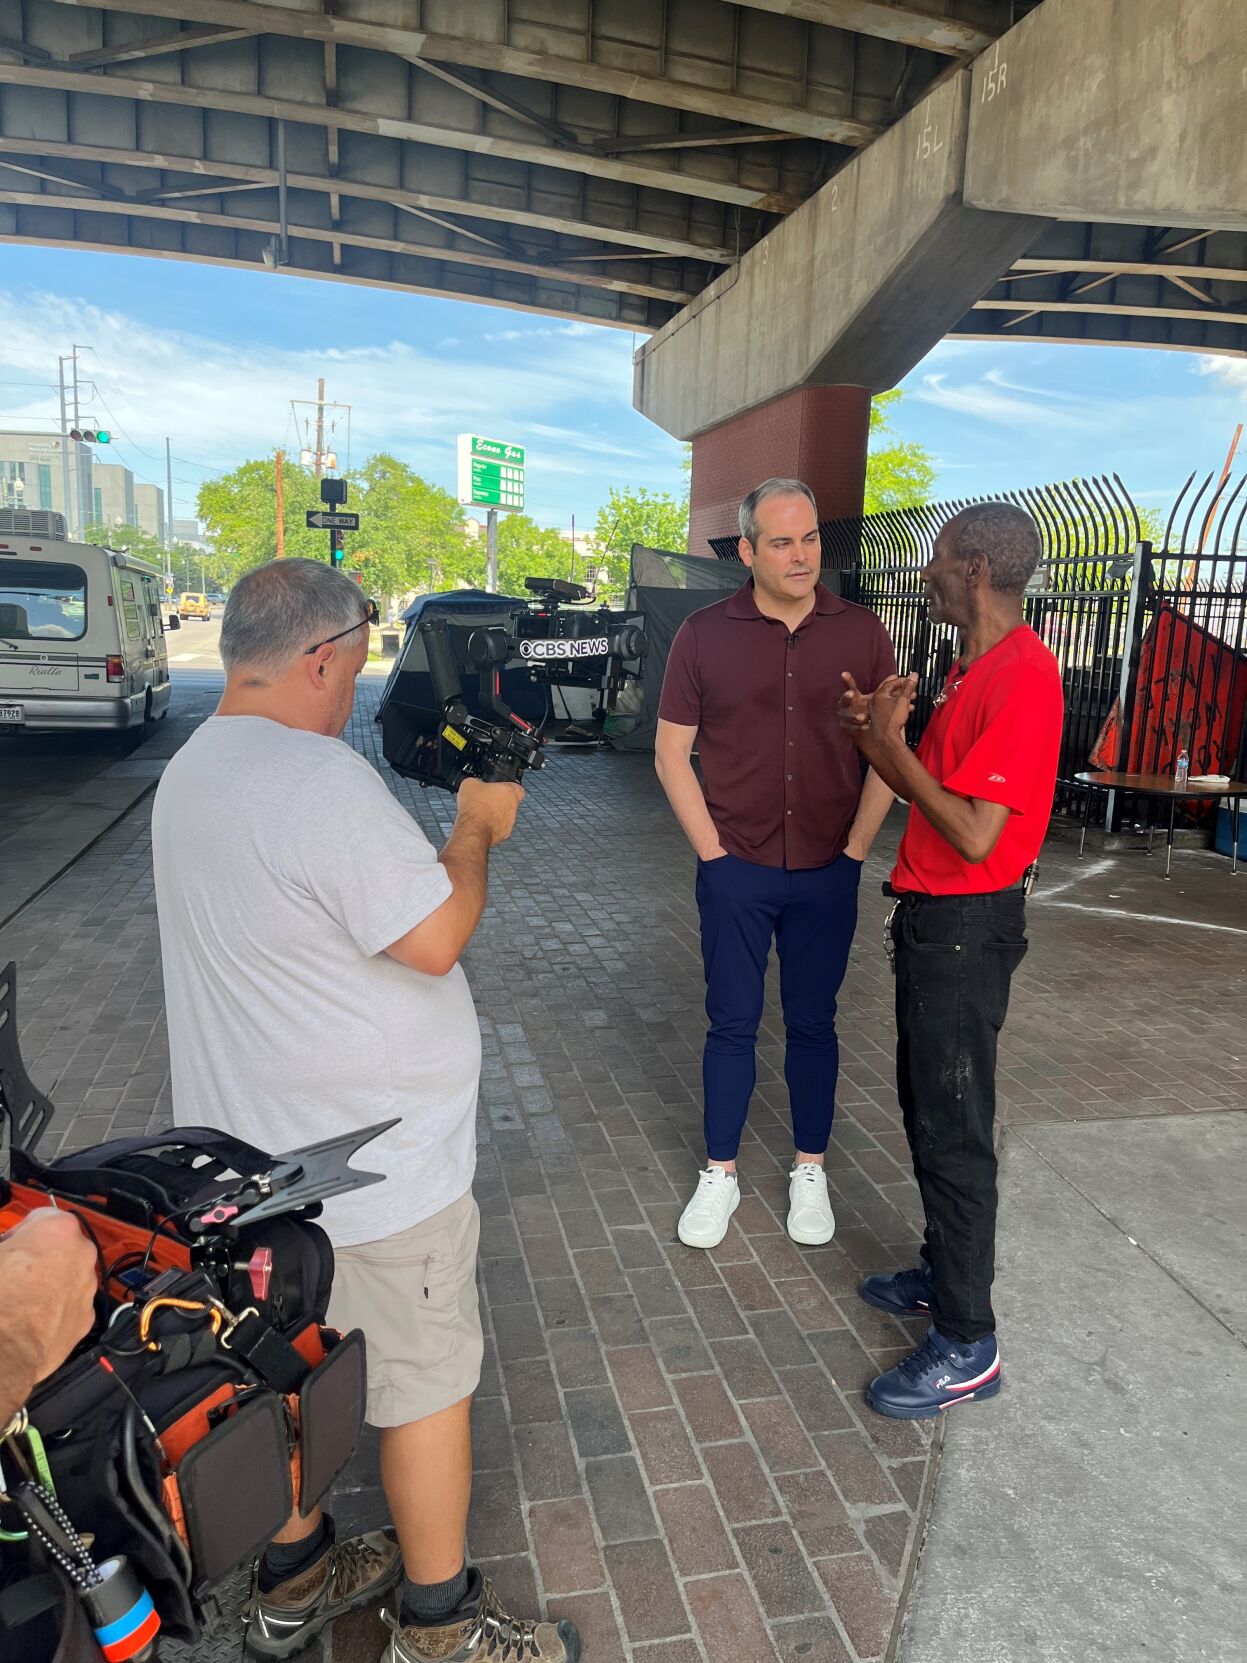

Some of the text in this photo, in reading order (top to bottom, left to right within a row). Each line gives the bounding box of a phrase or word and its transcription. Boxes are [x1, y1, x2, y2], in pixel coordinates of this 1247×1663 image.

[981, 62, 1008, 105] 15R
[916, 124, 943, 161] 15L
[831, 185, 838, 212] 2
[763, 240, 769, 265] 3
[504, 446, 521, 459] Gas
[322, 516, 353, 526] ONE WAY
[533, 638, 608, 657] CBS NEWS
[934, 1374, 951, 1389] FILA
